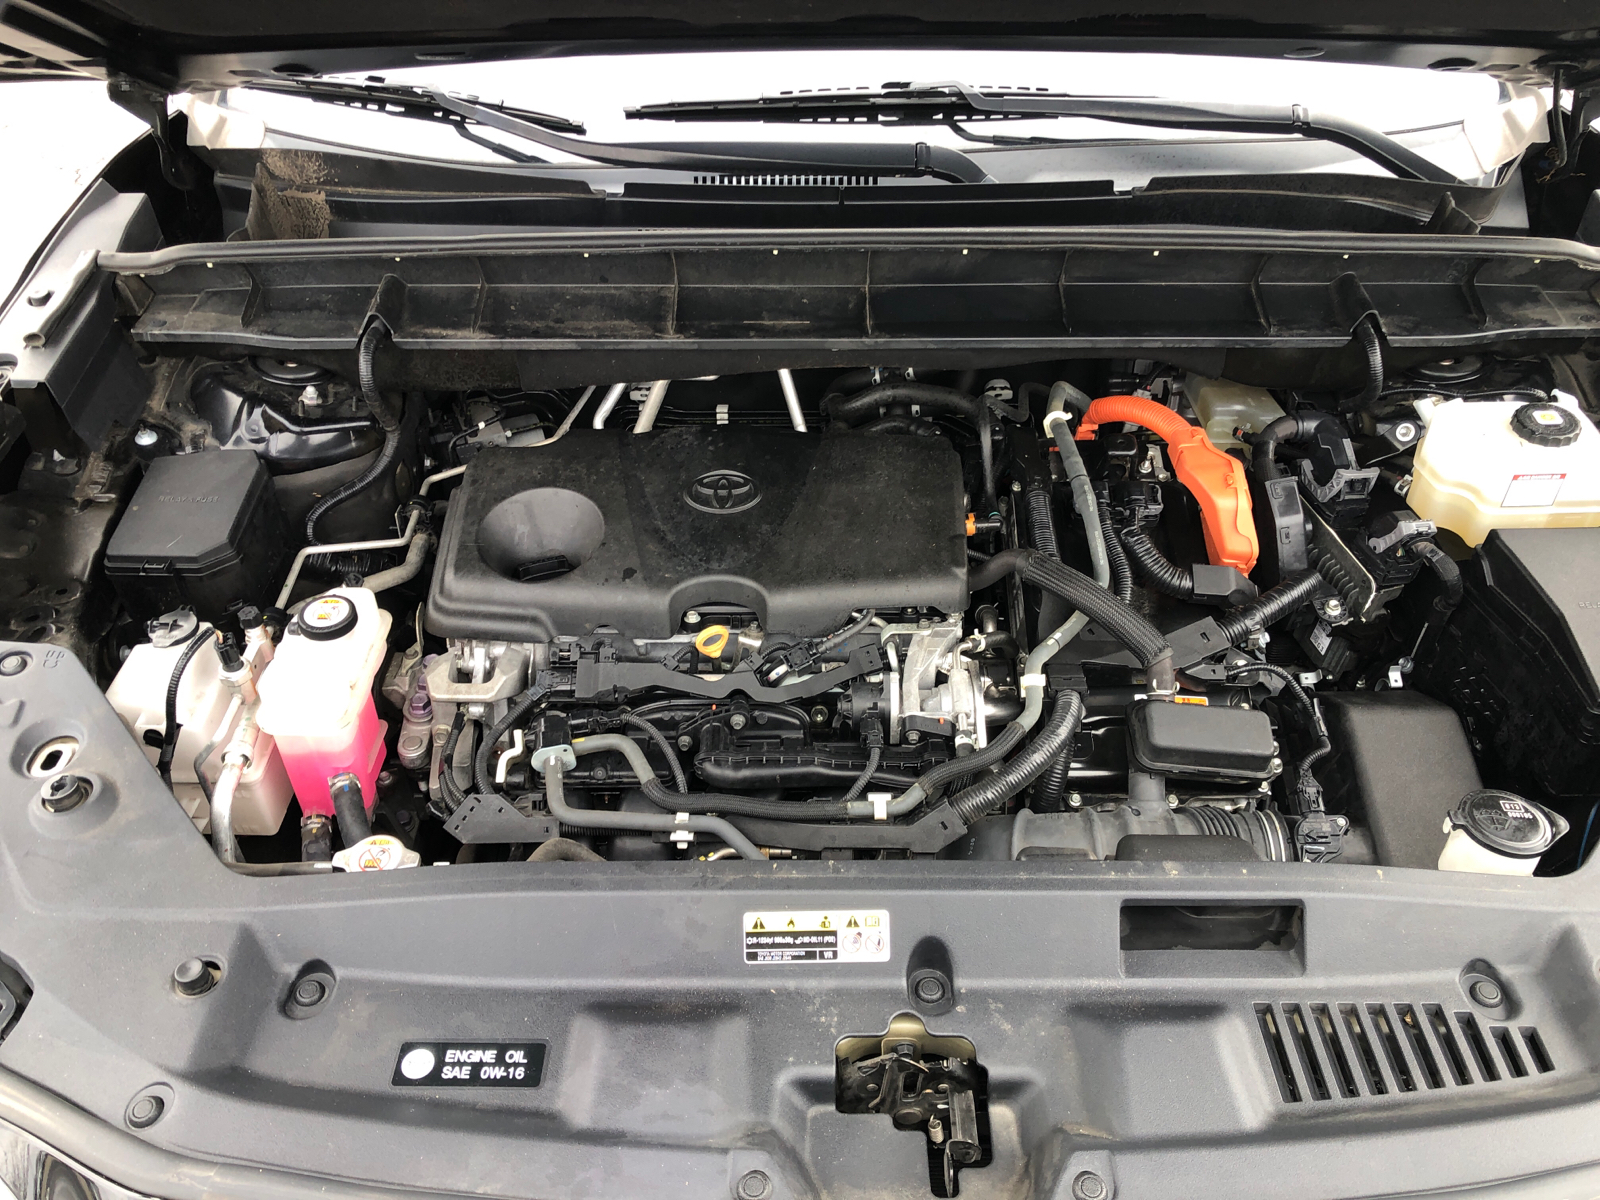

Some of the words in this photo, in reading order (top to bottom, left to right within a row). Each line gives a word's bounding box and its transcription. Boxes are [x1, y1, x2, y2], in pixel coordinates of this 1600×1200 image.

[823, 951, 834, 959] VR
[445, 1049, 497, 1063] ENGINE
[505, 1050, 528, 1064] OIL
[441, 1066, 472, 1079] SAE
[480, 1066, 526, 1080] 0W-16
